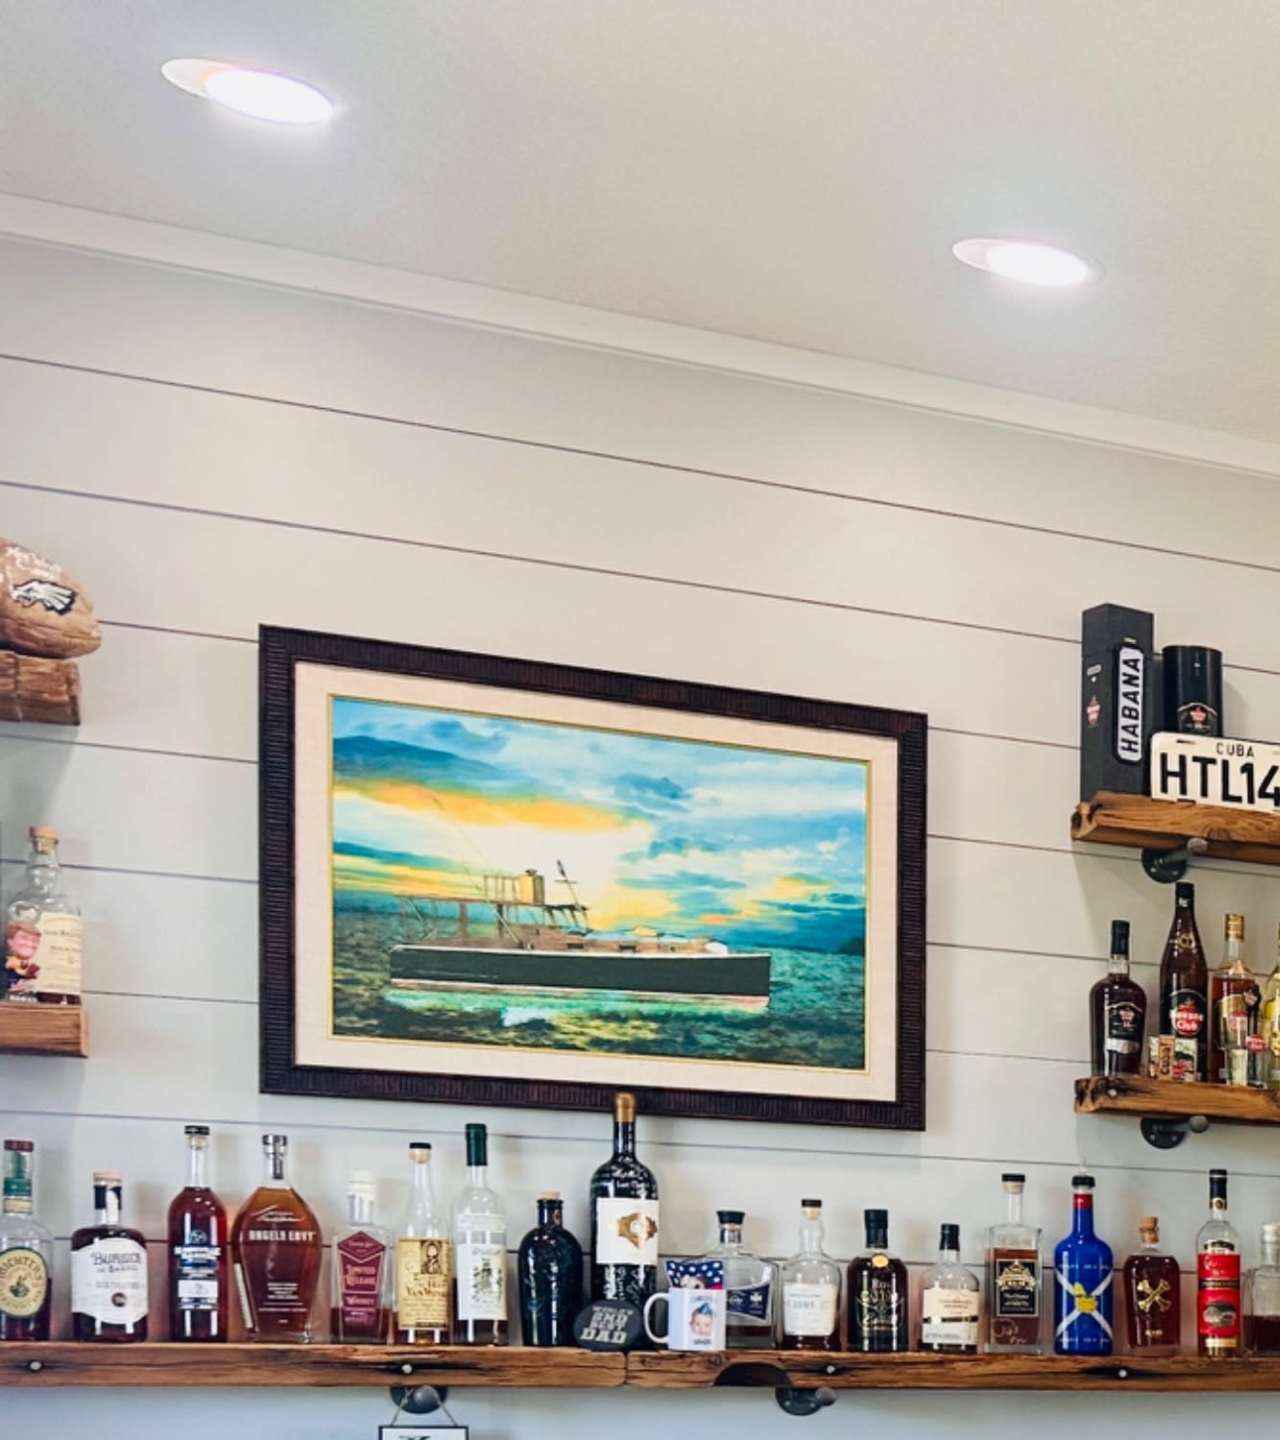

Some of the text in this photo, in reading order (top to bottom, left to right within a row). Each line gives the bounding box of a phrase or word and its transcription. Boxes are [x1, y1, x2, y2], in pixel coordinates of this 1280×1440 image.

[1120, 657, 1141, 754] HABANA
[1216, 742, 1256, 758] CUBA
[580, 1328, 627, 1344] DAD
